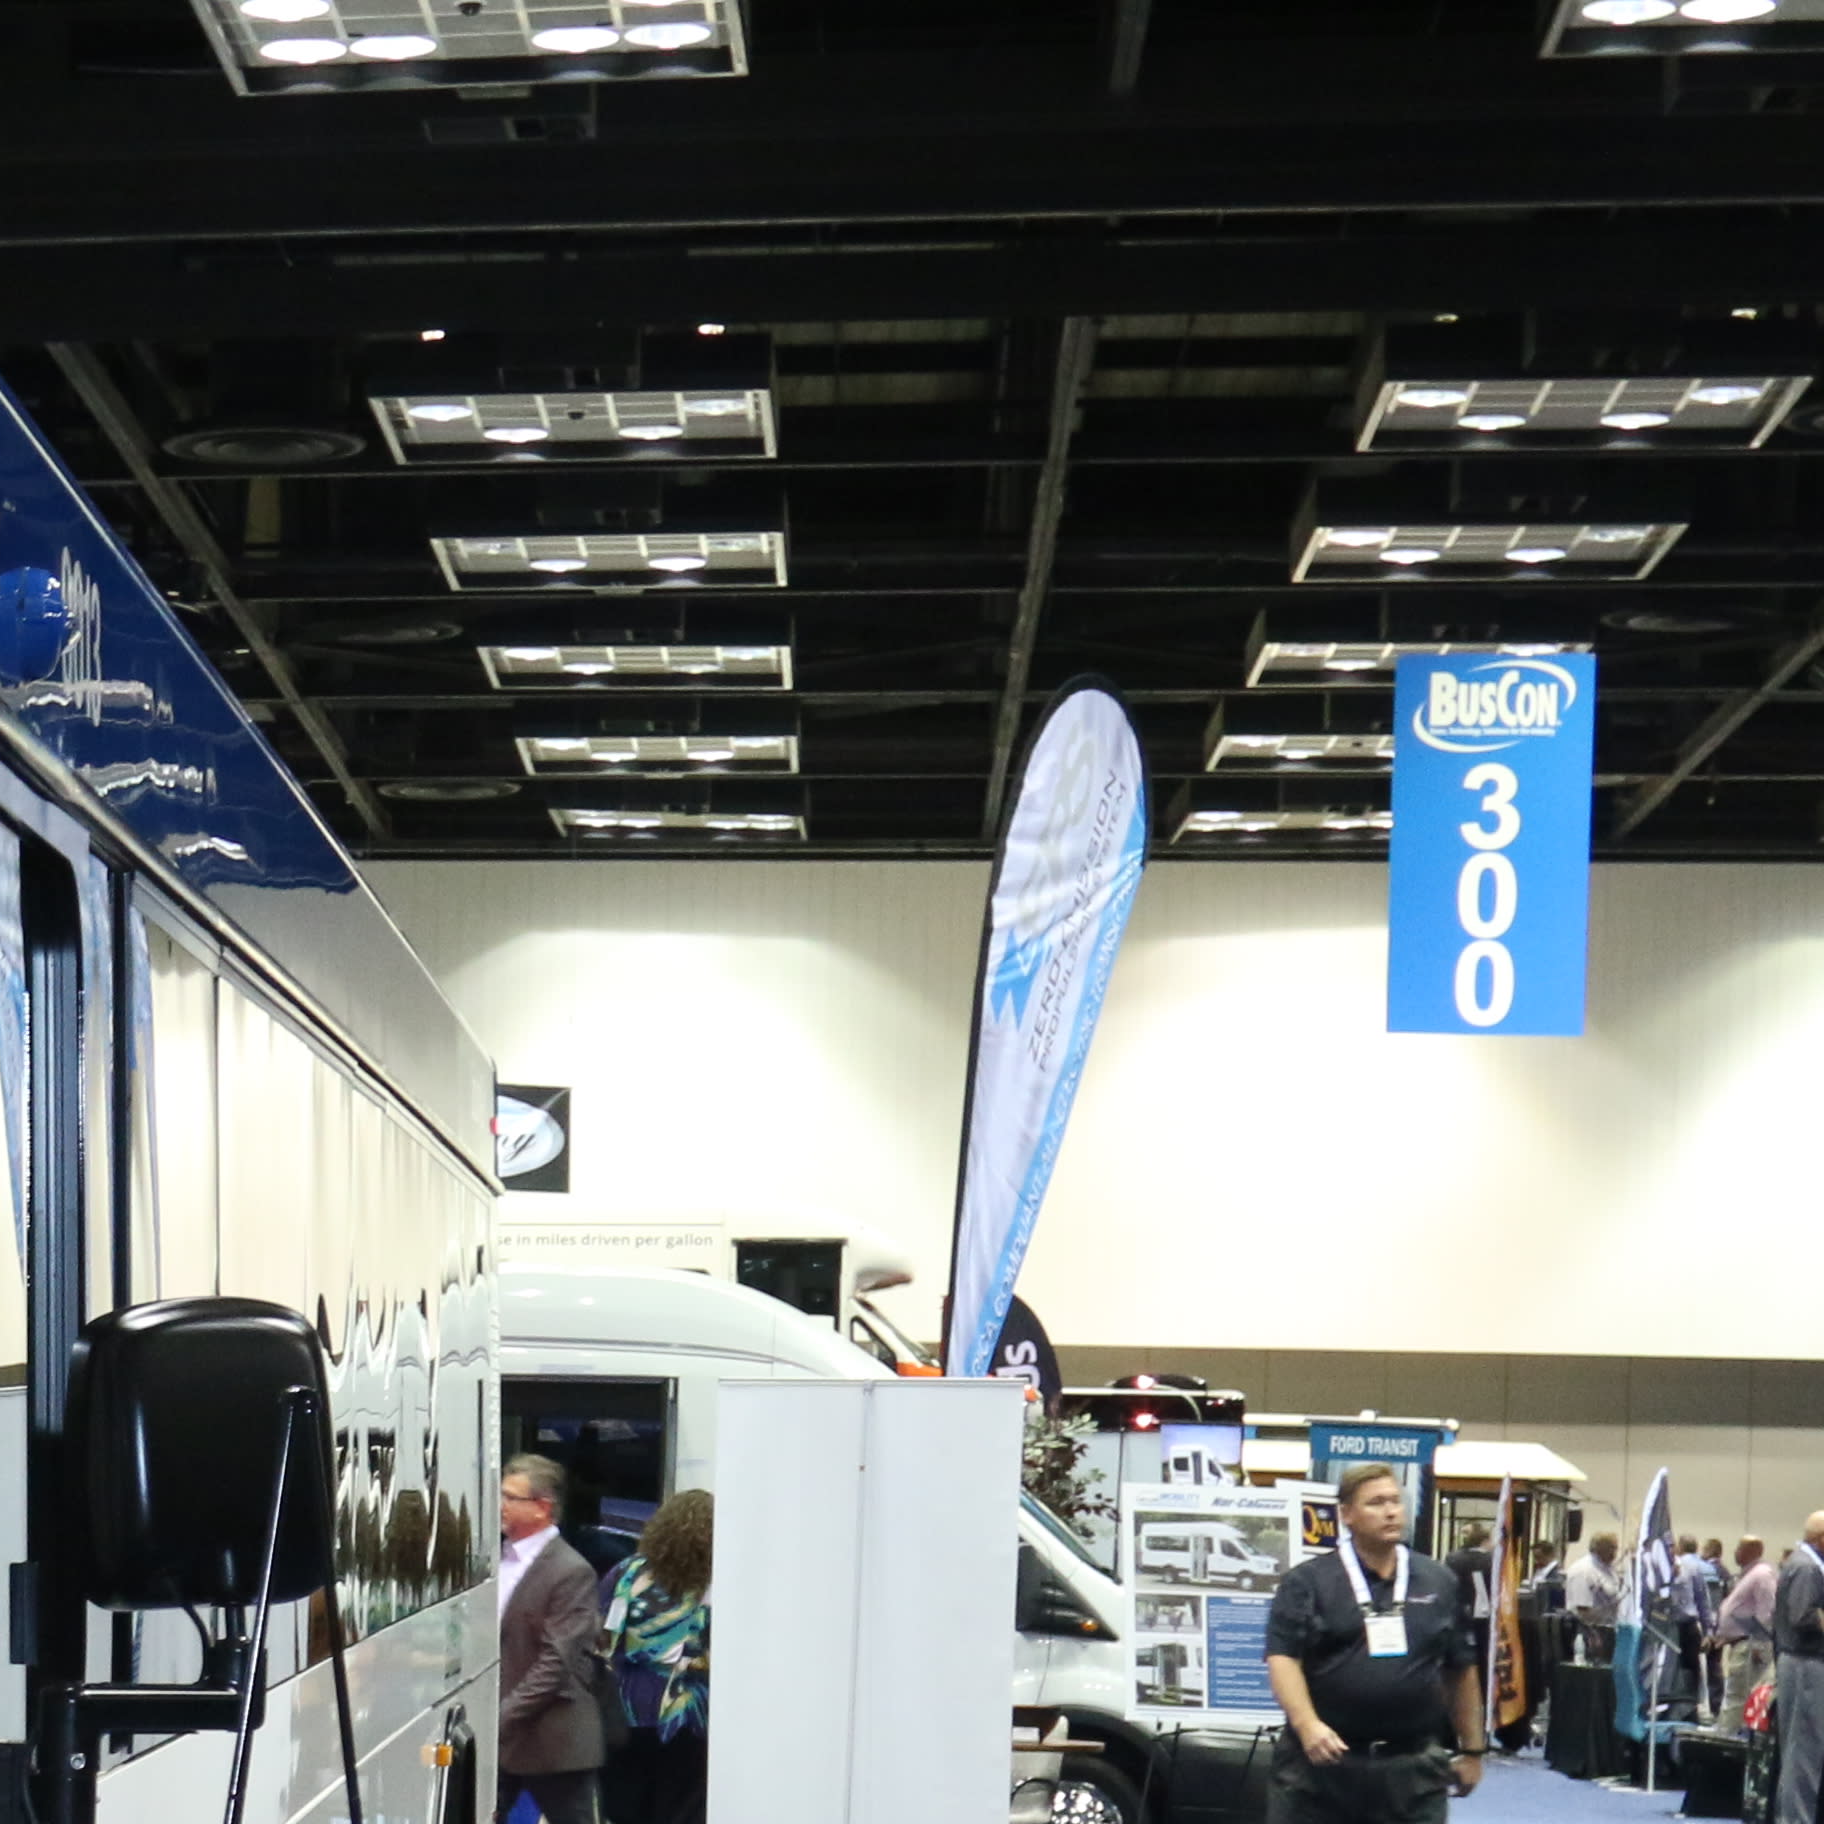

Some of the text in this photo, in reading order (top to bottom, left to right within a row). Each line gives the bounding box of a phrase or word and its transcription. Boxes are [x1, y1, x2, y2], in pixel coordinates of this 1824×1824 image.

[1454, 762, 1521, 1027] 300
[517, 1233, 531, 1247] in
[536, 1233, 577, 1247] miles
[581, 1233, 630, 1247] driven
[635, 1236, 661, 1251] per
[665, 1233, 714, 1251] gallon
[1329, 1434, 1420, 1457] FORD TRANSIT
